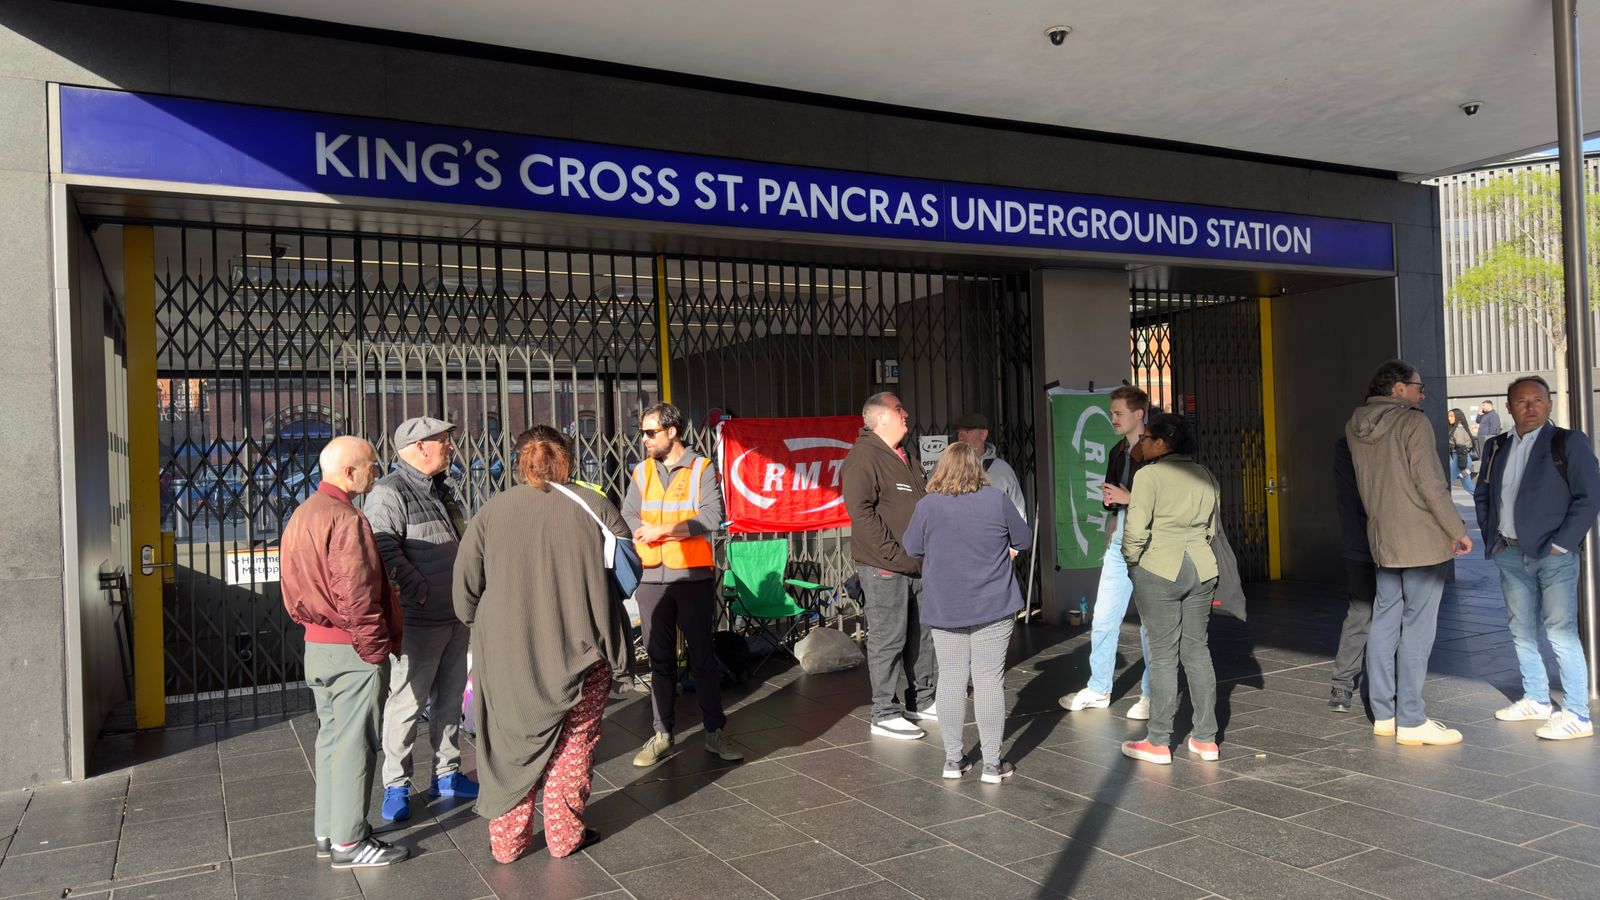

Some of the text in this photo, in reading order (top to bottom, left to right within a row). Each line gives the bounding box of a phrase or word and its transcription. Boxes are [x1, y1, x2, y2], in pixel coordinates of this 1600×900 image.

[315, 131, 1311, 254] KING'S CROSS ST. PANCRAS UNDERGROUND STATION
[762, 459, 844, 492] RMT
[1084, 438, 1109, 533] RMT
